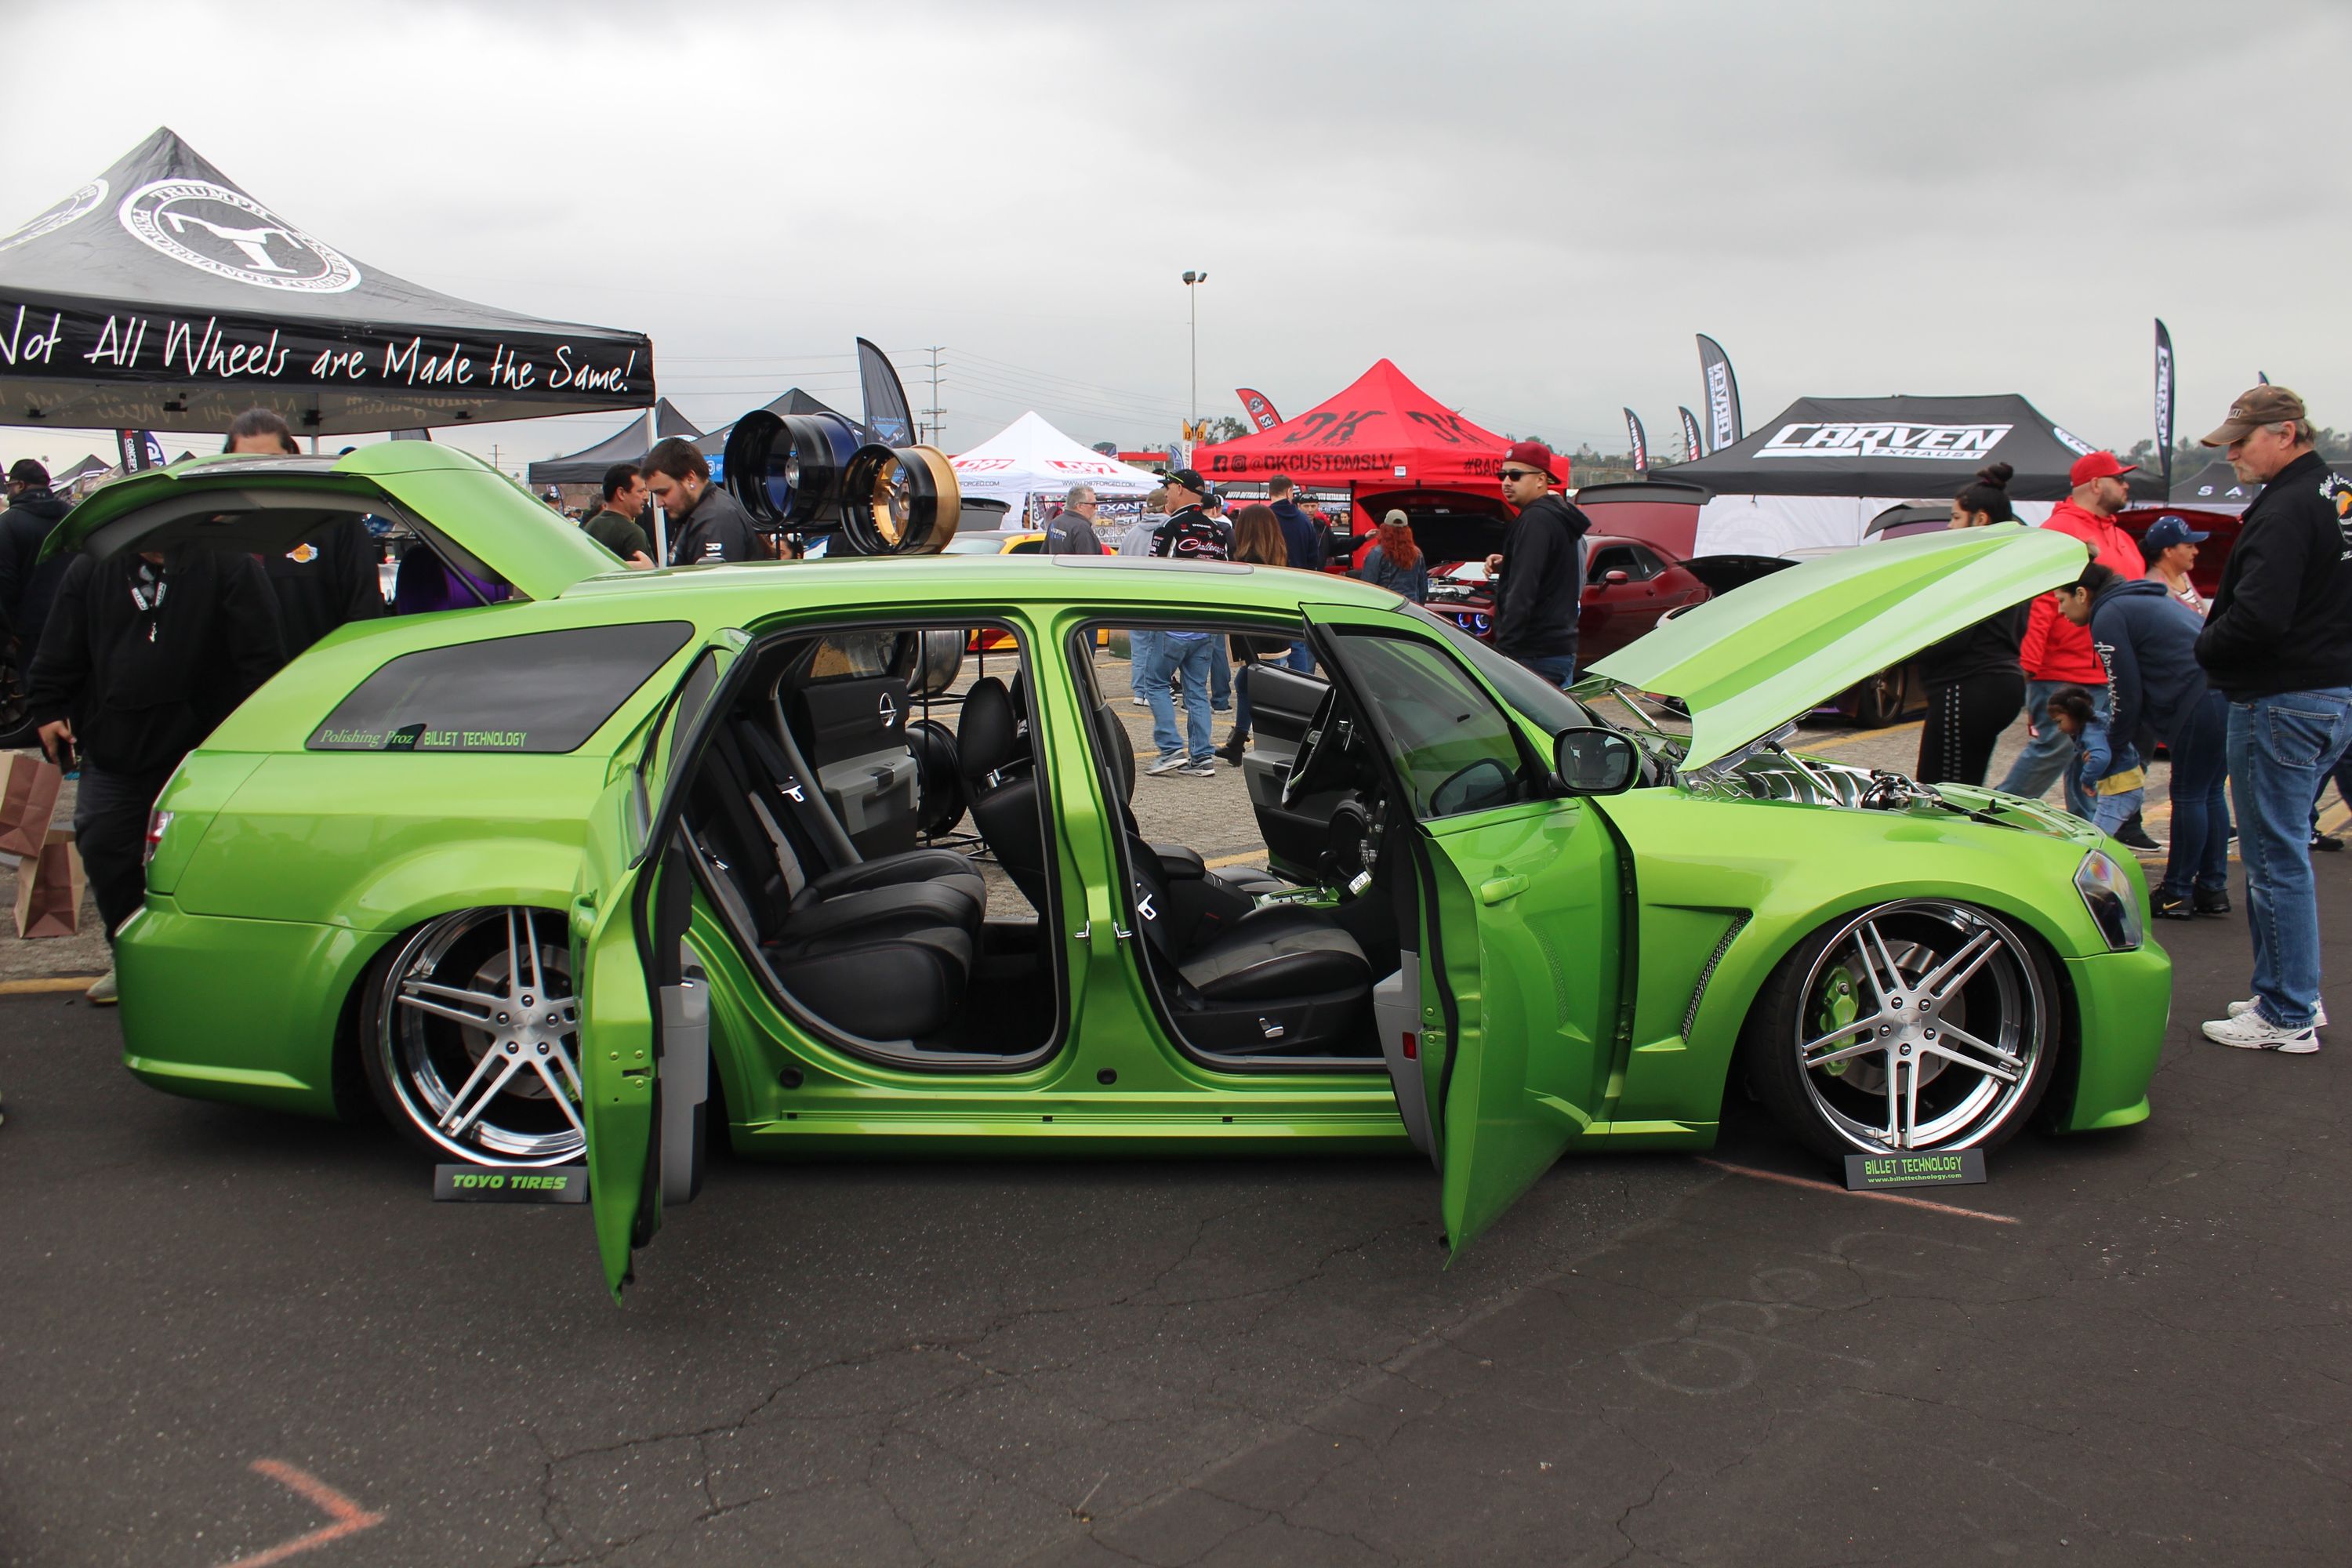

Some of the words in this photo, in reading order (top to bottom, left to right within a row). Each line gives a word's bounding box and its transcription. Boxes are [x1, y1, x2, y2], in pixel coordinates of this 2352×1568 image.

[148, 186, 272, 220] TRIUMPH
[132, 207, 274, 285] PERFORMANCE
[0, 305, 62, 365] Not
[84, 315, 147, 368] All
[165, 316, 290, 377] Wheels
[311, 349, 366, 379] are
[383, 336, 474, 385] Made
[489, 343, 535, 390] the
[549, 346, 636, 392] Same!
[1764, 423, 2009, 451] CARVEN
[1871, 449, 1984, 458] EXHAUST
[1098, 502, 1140, 511] EXANI
[320, 729, 381, 747] Polishing
[383, 731, 416, 745] Proz
[423, 731, 459, 746] BILLET
[463, 731, 528, 746] TECHNOLOGY
[1864, 1160, 1897, 1175] BILLET
[1901, 1156, 1962, 1174] TECHNOLOGY
[452, 1174, 505, 1189] TOYO
[510, 1175, 568, 1190] TIRES
[1867, 1174, 1962, 1183] www.billettechnology.com
